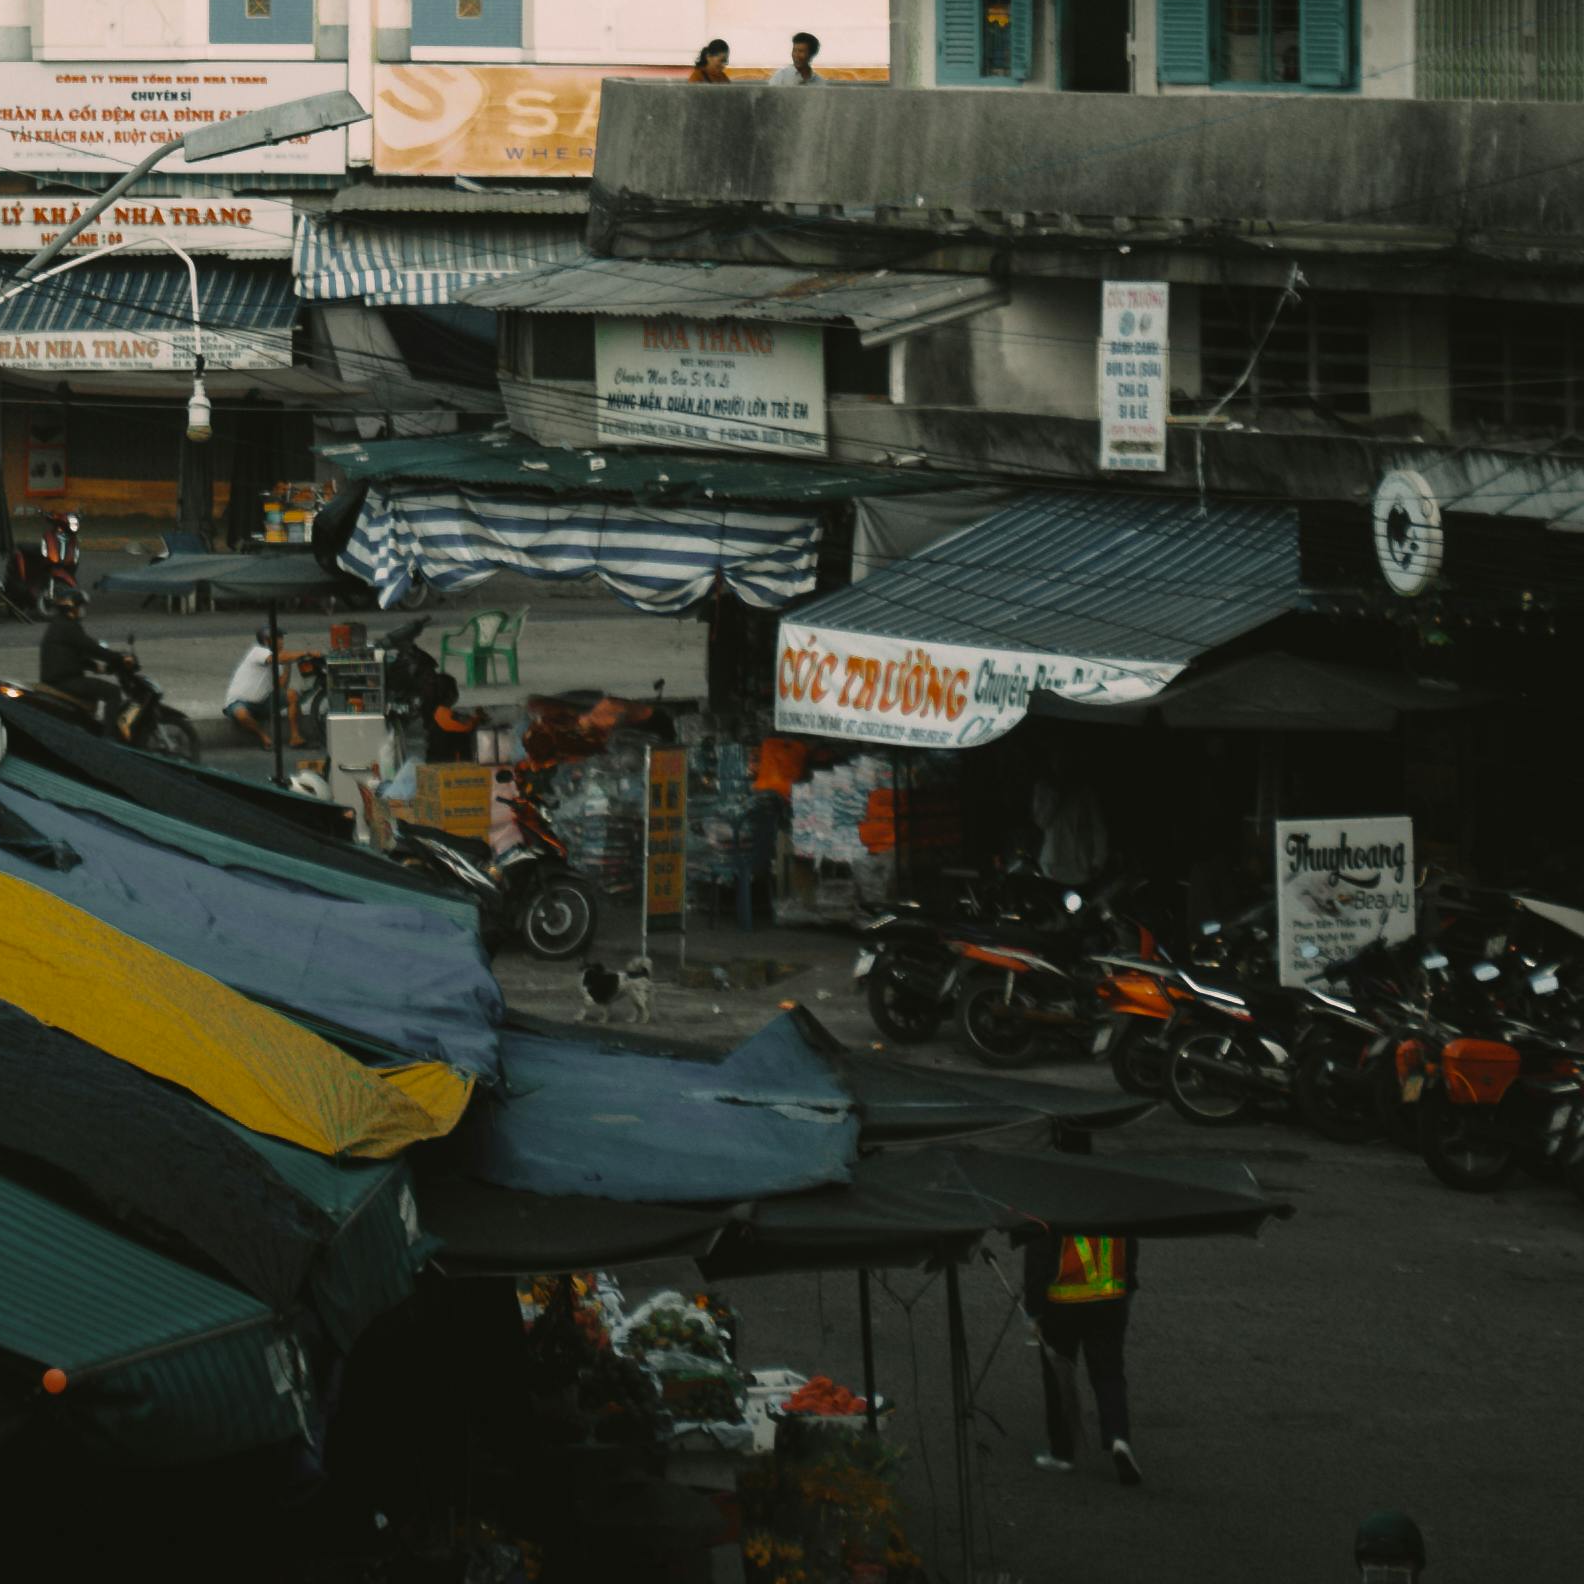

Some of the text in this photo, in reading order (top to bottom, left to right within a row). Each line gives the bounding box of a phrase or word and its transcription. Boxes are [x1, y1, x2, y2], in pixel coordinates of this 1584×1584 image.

[131, 89, 179, 102] CHUYÊN
[42, 109, 64, 122] RA
[69, 104, 97, 122] GỐI
[101, 107, 136, 125] ĐỆM
[140, 109, 169, 122] GIA
[174, 106, 215, 122] ĐÌNH
[34, 129, 77, 143] KHÁCH
[114, 207, 165, 226] NHA
[172, 206, 253, 226] TRANG
[45, 339, 87, 359] NHA
[93, 339, 160, 360] TRANG
[778, 634, 838, 703] CÚC
[838, 645, 970, 722] TRƯỜNG
[1354, 890, 1409, 914] Beauty
